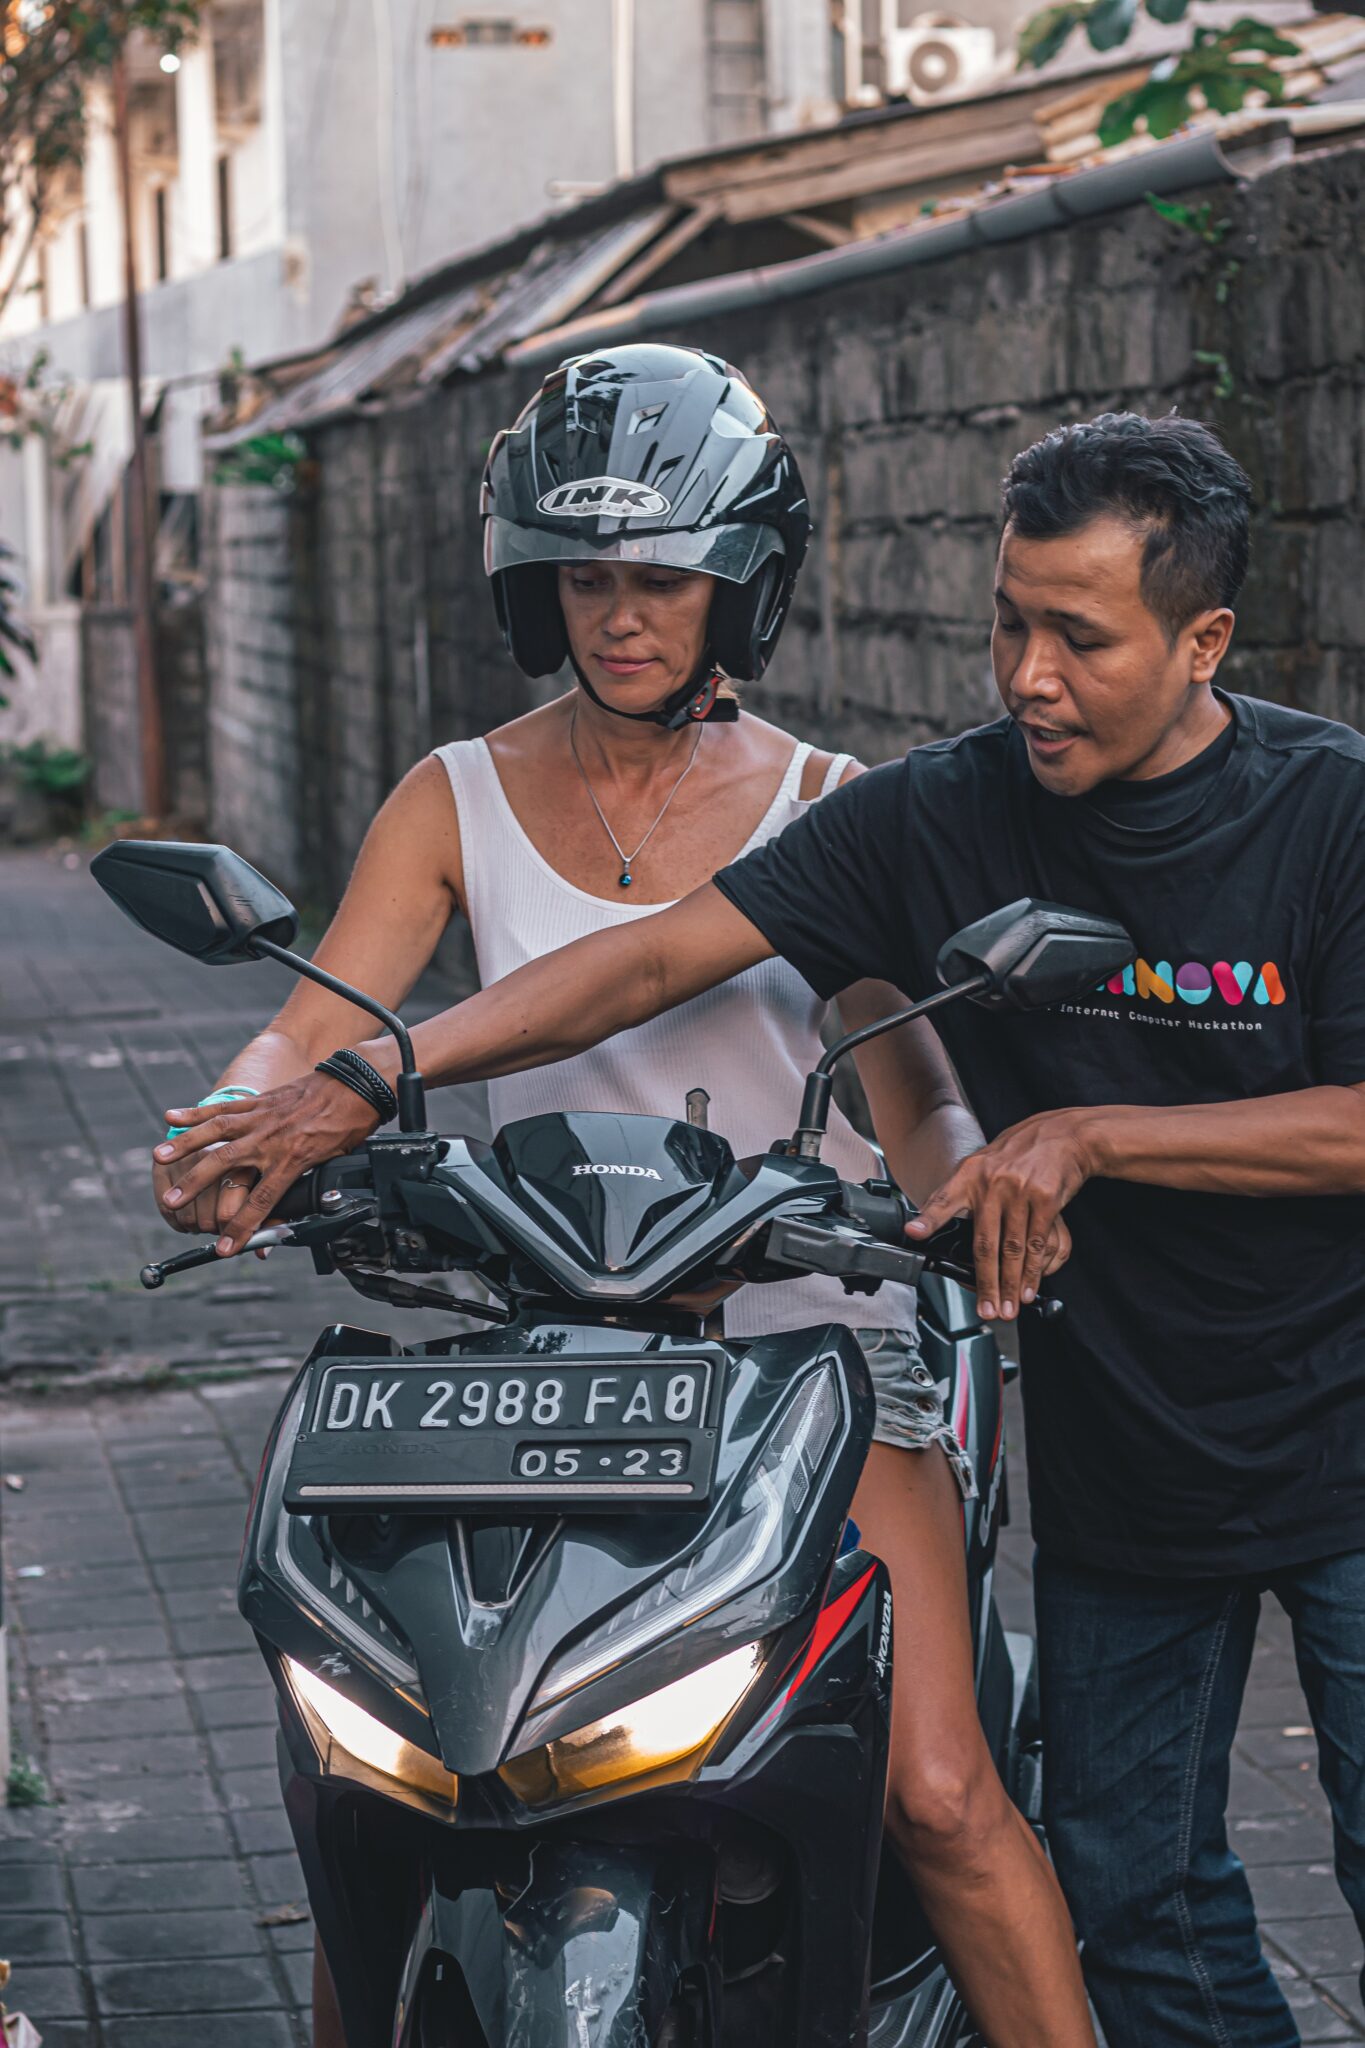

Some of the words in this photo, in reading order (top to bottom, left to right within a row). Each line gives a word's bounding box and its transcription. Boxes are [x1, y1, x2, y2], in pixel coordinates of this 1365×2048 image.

[550, 485, 656, 509] INK
[1060, 1003, 1120, 1020] Internet
[1128, 1011, 1182, 1028] Computer
[1188, 1019, 1262, 1031] Hackathon
[572, 1164, 664, 1181] HONDA
[327, 1381, 403, 1429] DK
[419, 1379, 563, 1428] 2988
[341, 1442, 441, 1455] HONDA
[875, 1589, 892, 1678] HONDA
